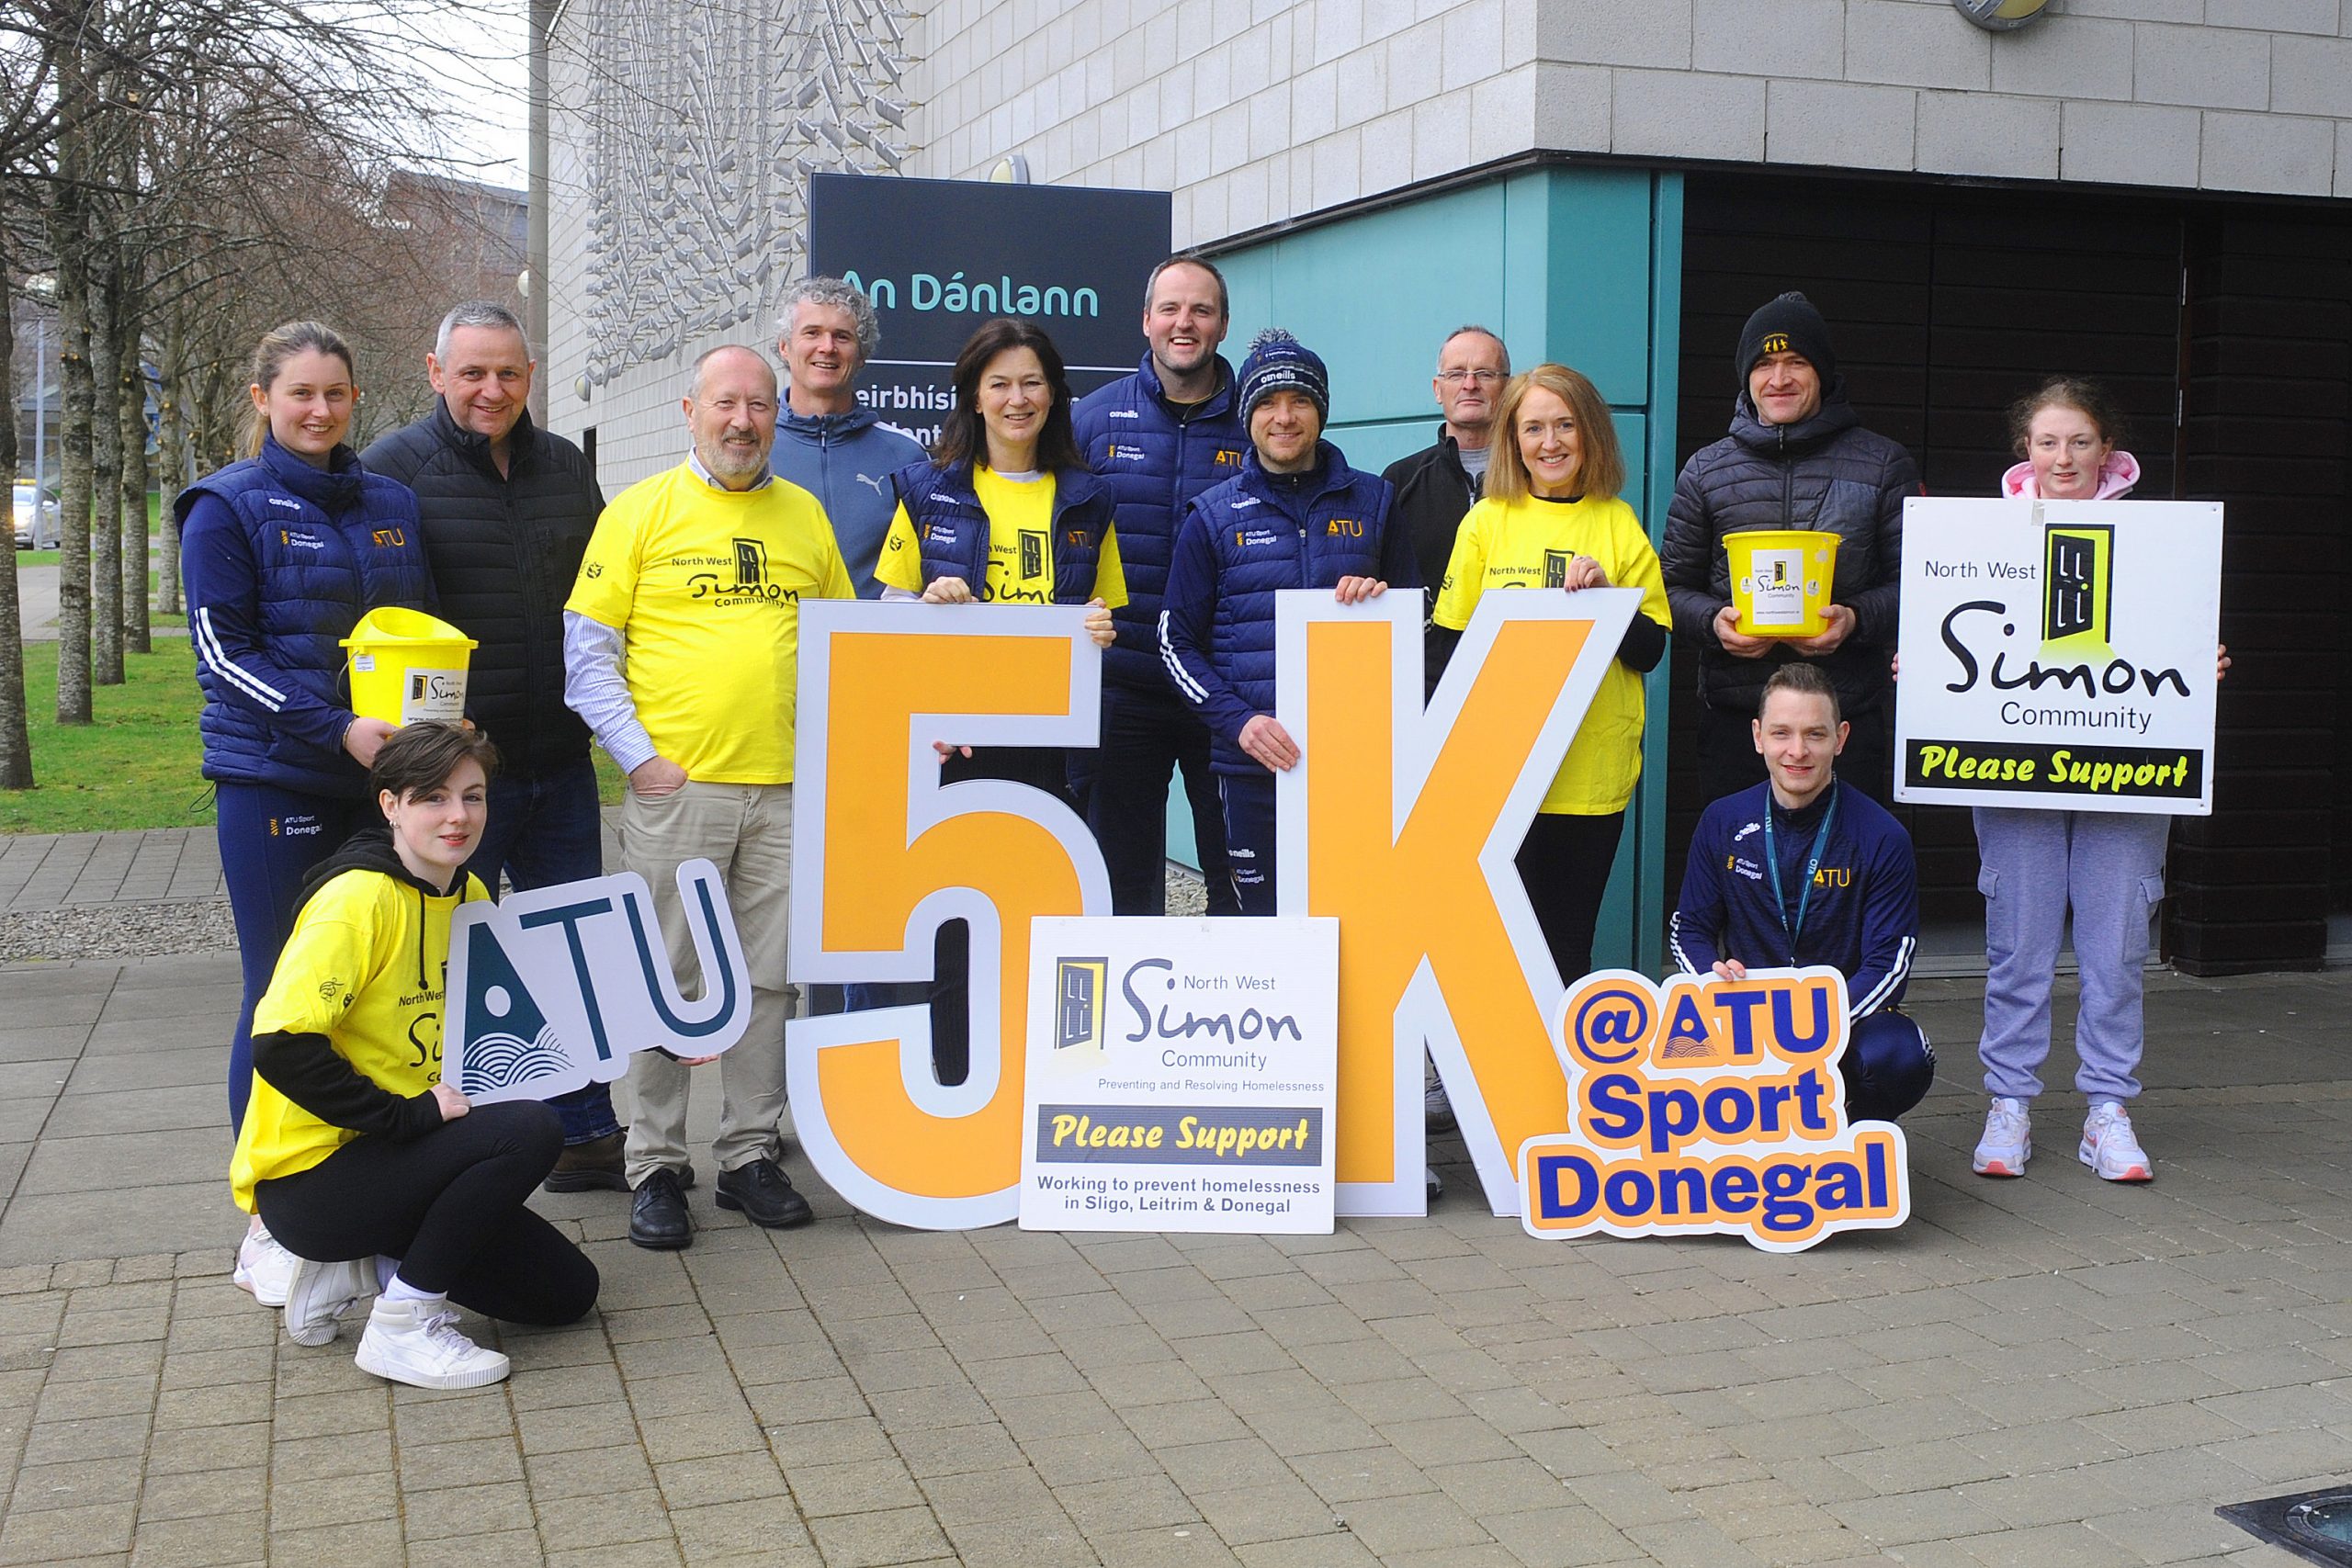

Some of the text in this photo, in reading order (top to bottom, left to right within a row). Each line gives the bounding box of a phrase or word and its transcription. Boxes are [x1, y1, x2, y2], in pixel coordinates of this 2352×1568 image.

[842, 270, 1099, 317] An Dánlann
[855, 384, 956, 410] eirbhísí
[1116, 451, 1145, 460] Donegal
[372, 528, 405, 547] ATU
[1328, 520, 1363, 536] ATU
[291, 539, 324, 549] Donegal
[995, 545, 1017, 554] West
[1246, 536, 1276, 546] Donegal
[672, 557, 732, 566] North West
[1489, 567, 1541, 575] North West
[1925, 560, 2036, 580] North West
[1758, 575, 1800, 592] Simon
[1940, 600, 2190, 699] Simon
[2000, 701, 2152, 735] Community
[1919, 745, 2188, 793] Please Support
[1814, 868, 1850, 887] ATU
[462, 878, 735, 1095] ATU
[1184, 976, 1275, 990] North West
[399, 992, 424, 1007] North
[1123, 958, 1302, 1044] Simon
[1575, 987, 1829, 1064] @ATU
[1162, 1050, 1267, 1072] Community
[1098, 1078, 1324, 1092] Preventing and Resolving Homelessness
[1589, 1068, 1826, 1153] Sport
[1051, 1114, 1308, 1157] Please Support
[1037, 1176, 1320, 1194] Working to prevent homelessness
[1537, 1143, 1887, 1231] Donegal
[1064, 1196, 1291, 1215] in Sligo, Leitrim & Donegal
